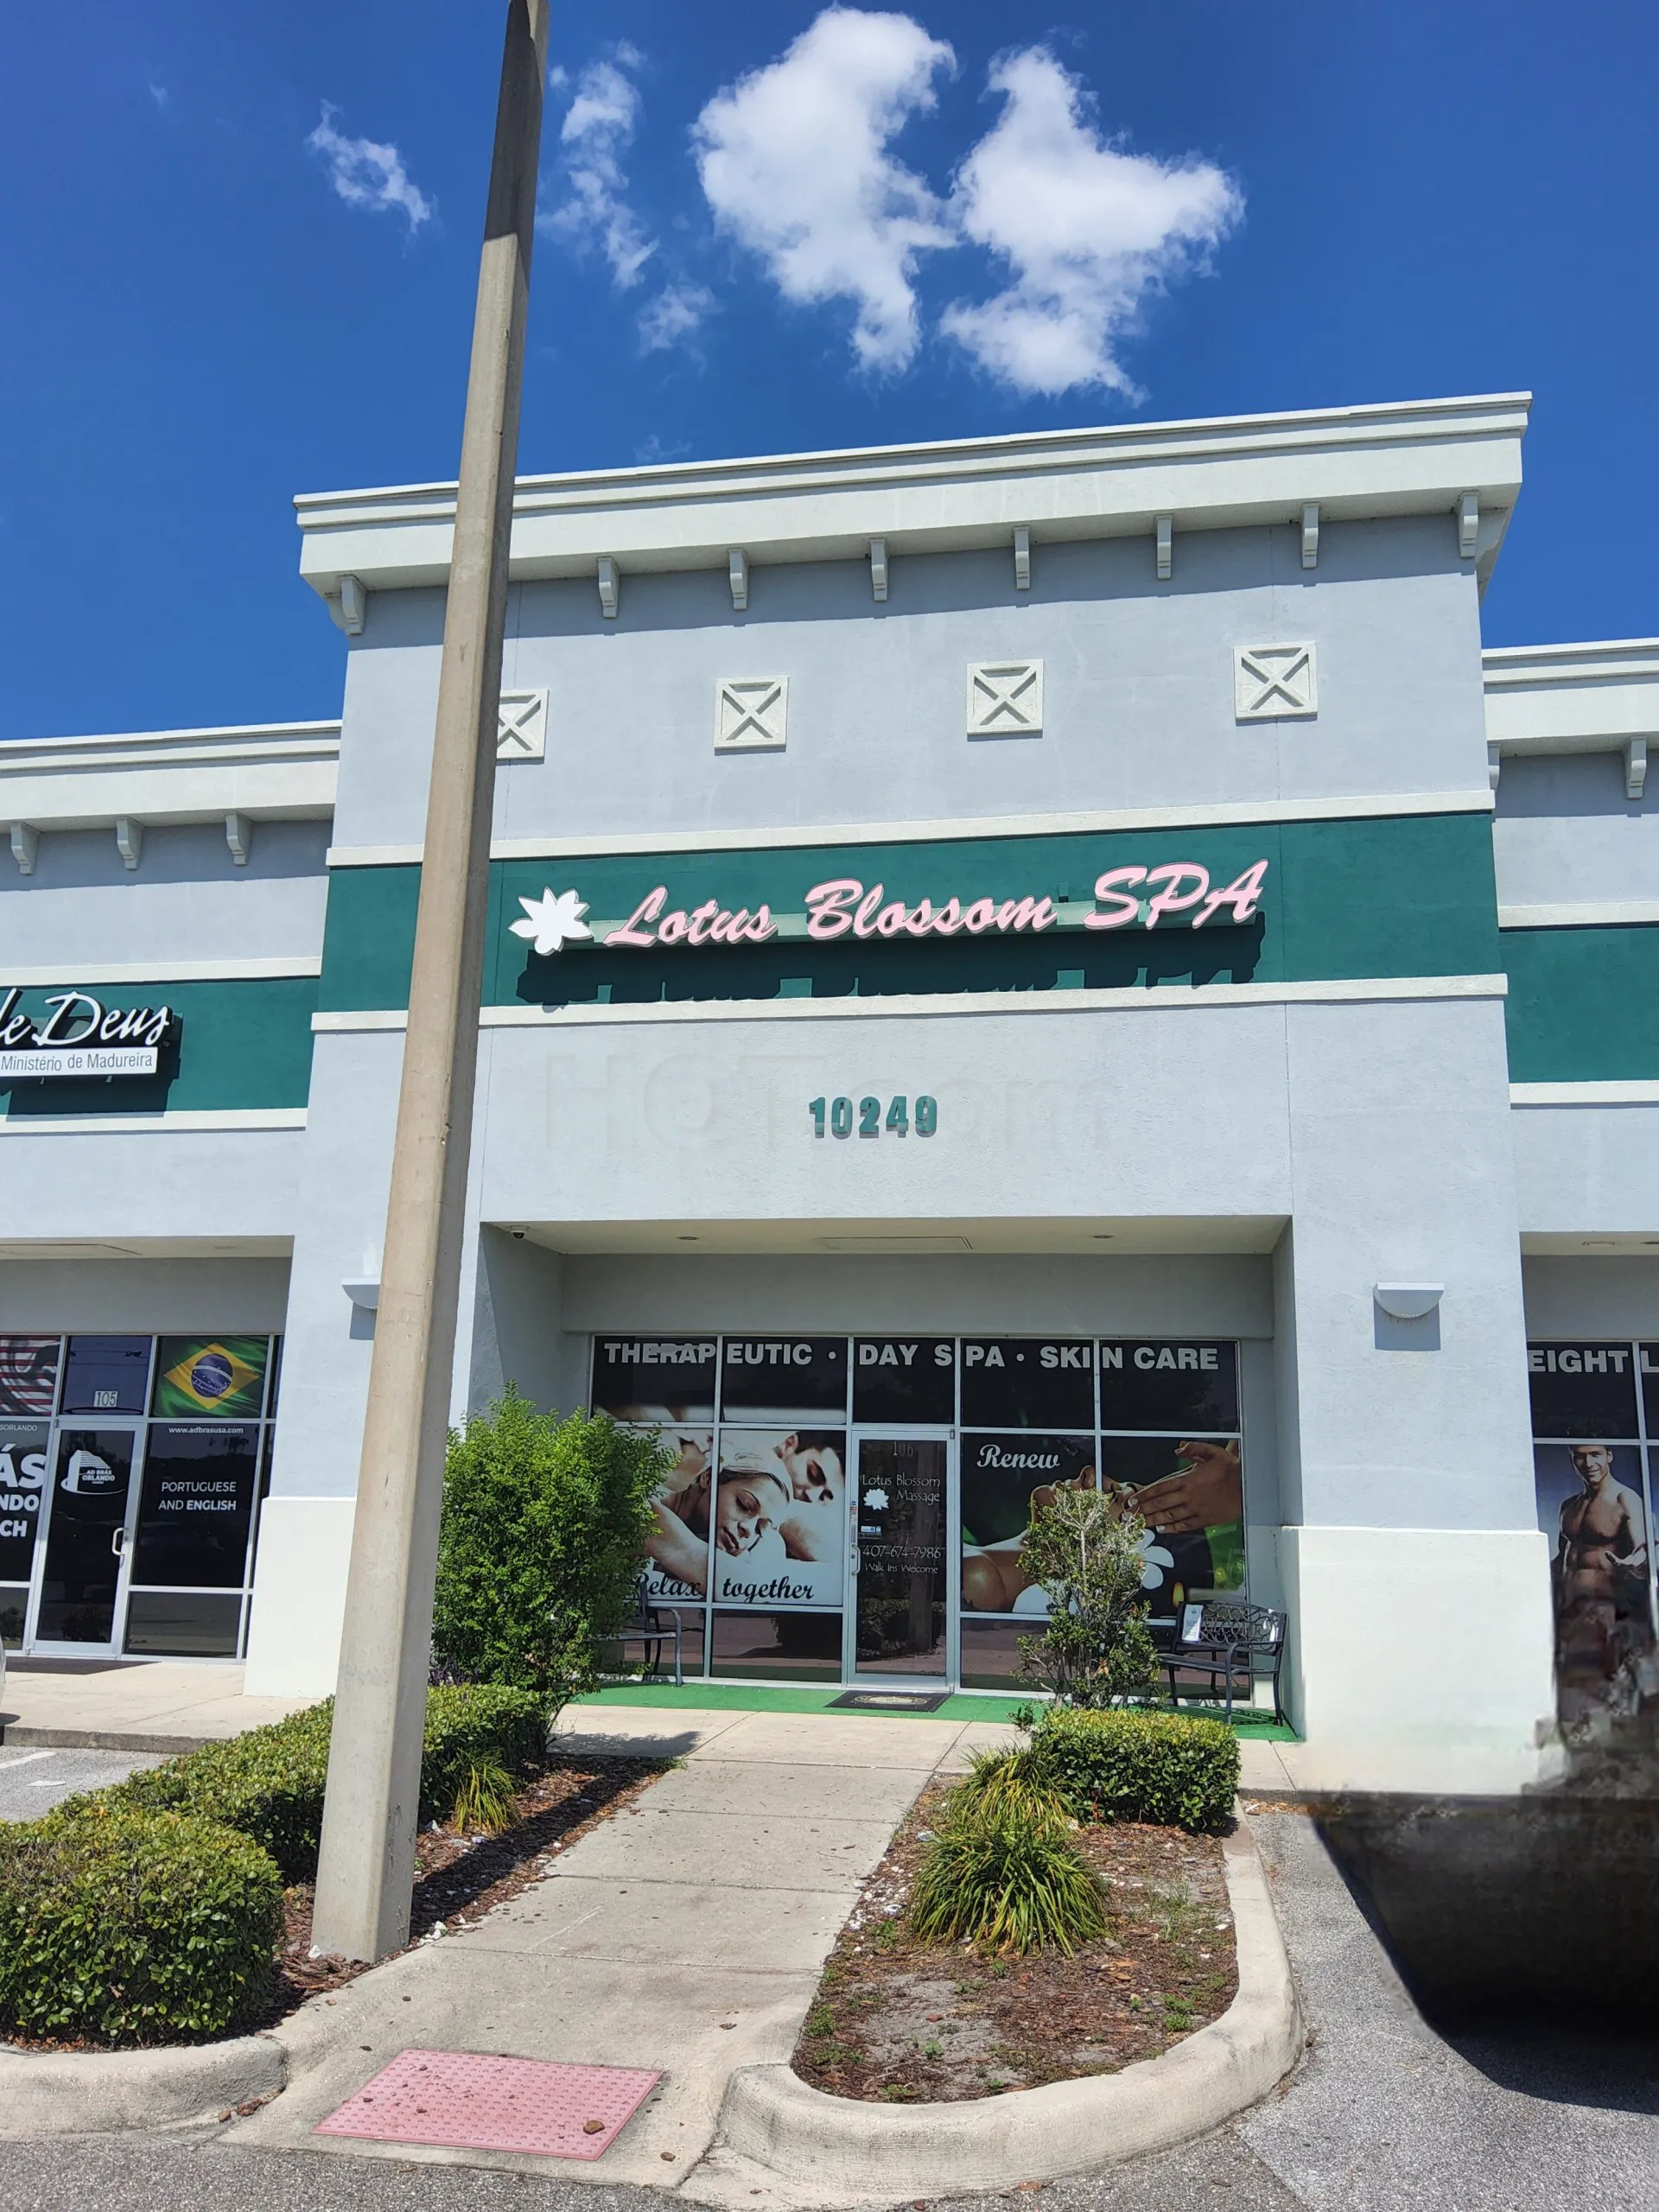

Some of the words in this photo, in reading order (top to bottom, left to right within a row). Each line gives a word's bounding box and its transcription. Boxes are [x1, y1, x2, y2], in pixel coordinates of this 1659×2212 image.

[603, 883, 779, 949] Lotus
[804, 878, 1061, 943] Blossom
[1083, 858, 1269, 930] SPA
[32, 991, 170, 1046] Deus
[1, 1055, 61, 1072] Ministério
[67, 1053, 83, 1070] de
[86, 1052, 153, 1069] Madureira
[809, 1096, 938, 1139] 10249
[604, 1343, 812, 1365] THERAPEUTIC
[859, 1344, 918, 1366] DAY
[935, 1344, 1005, 1367] SPA
[1039, 1346, 1123, 1369] SKIN
[1134, 1347, 1219, 1370] CARE
[1528, 1350, 1629, 1373] EIGHT
[97, 1392, 117, 1407] 105
[893, 1441, 913, 1456] 106
[976, 1444, 1061, 1469] Renew
[161, 1482, 237, 1492] PORTUGUESE
[862, 1473, 892, 1486] Lotus
[896, 1472, 940, 1487] Blossom
[158, 1501, 183, 1510] AND
[187, 1500, 237, 1510] ENGLISH
[896, 1489, 940, 1505] Massage
[862, 1545, 941, 1560] 407-674-7986
[865, 1561, 885, 1572] Walk
[901, 1563, 939, 1573] Welcome
[722, 1575, 815, 1603] together
